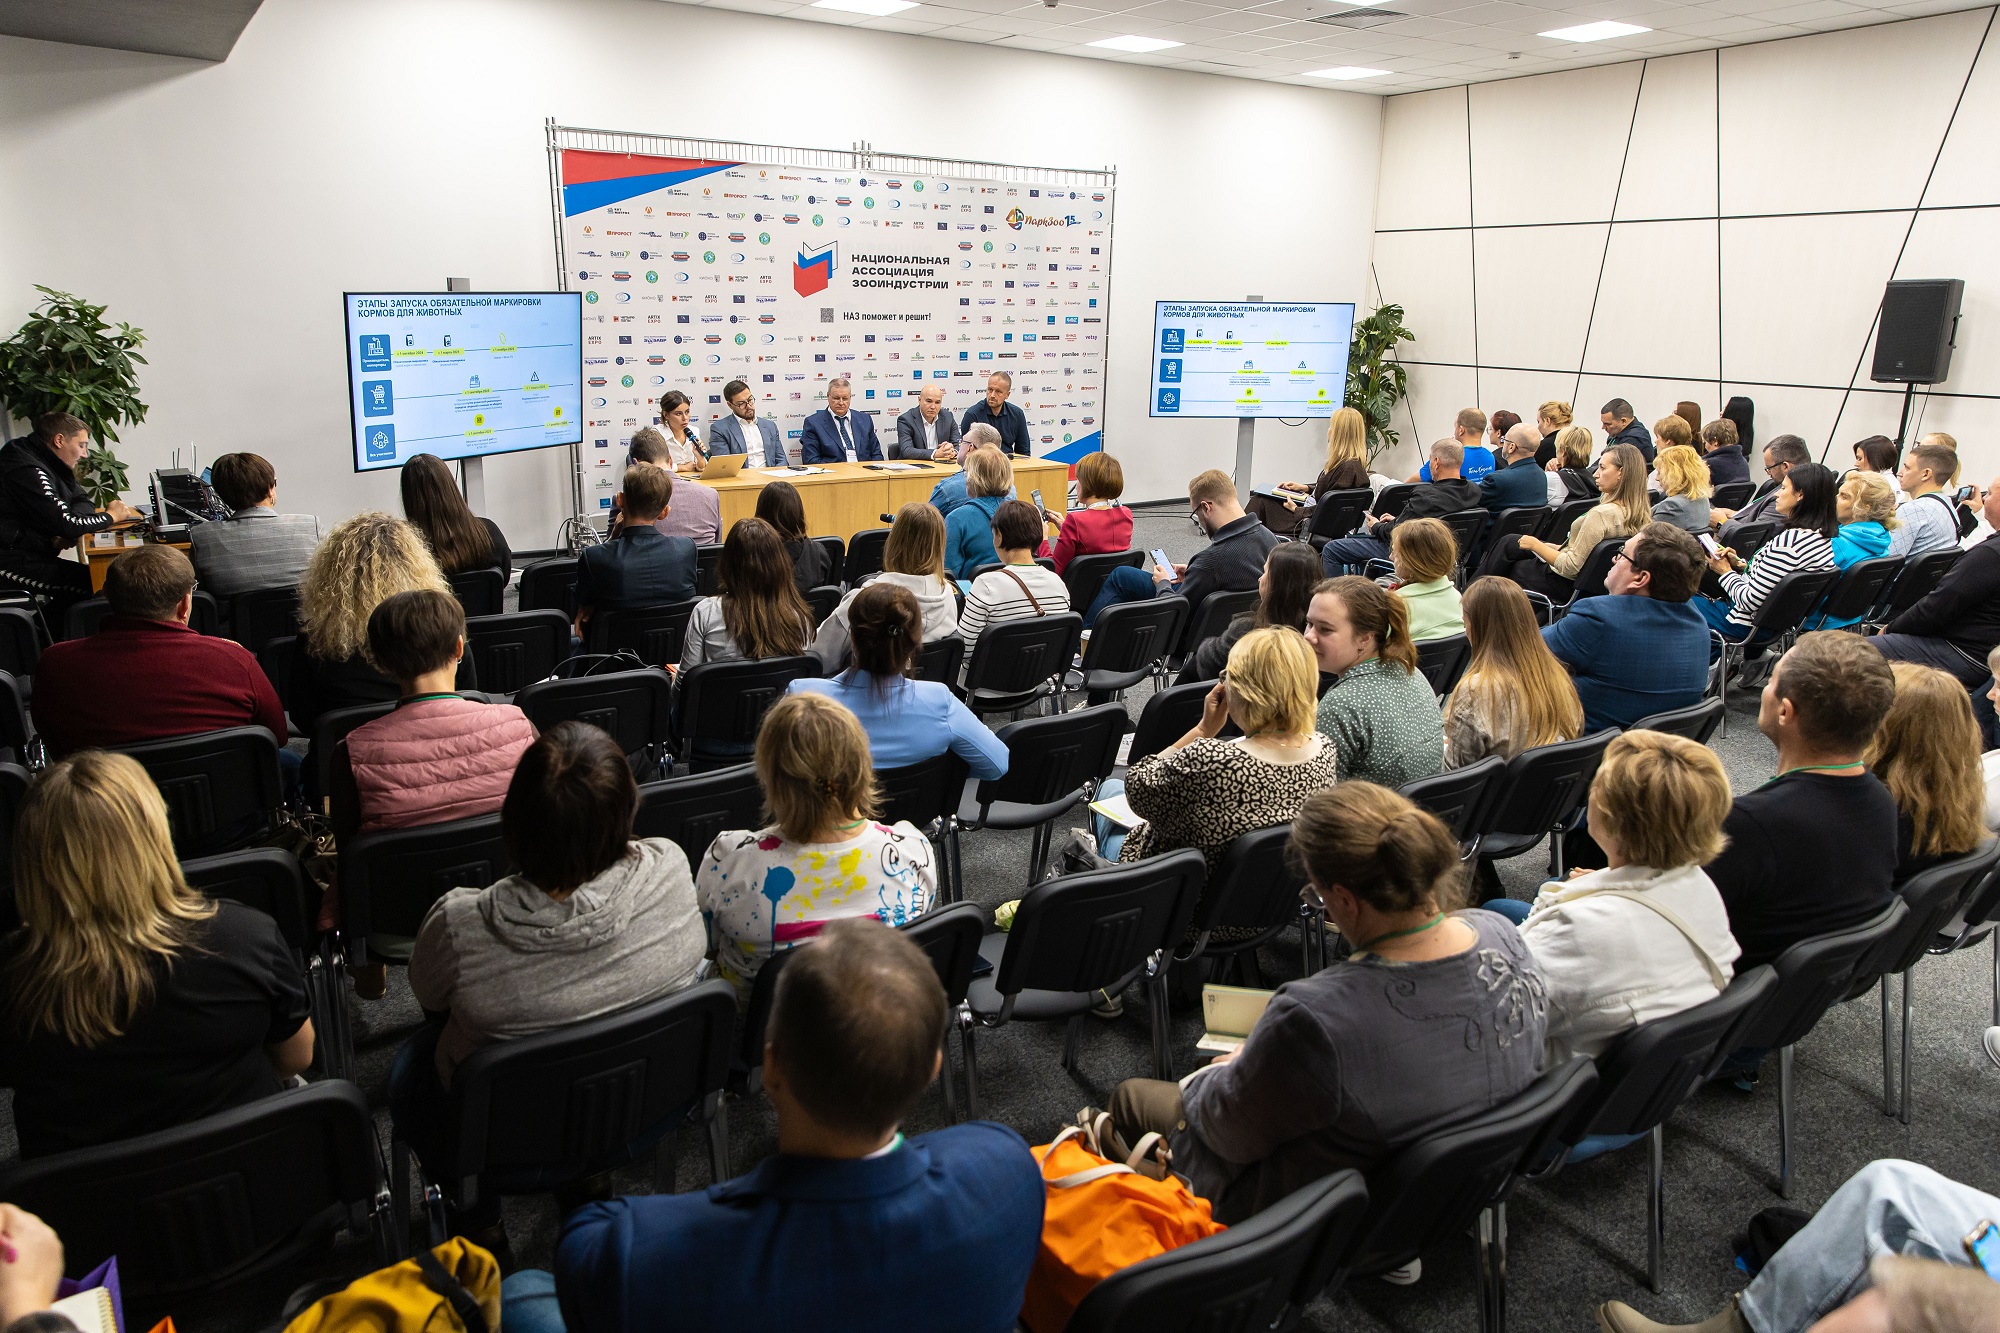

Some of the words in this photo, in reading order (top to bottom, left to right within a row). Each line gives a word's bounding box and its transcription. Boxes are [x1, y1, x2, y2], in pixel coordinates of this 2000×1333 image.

[851, 254, 950, 265] НАЦИОНАЛЬНАЯ
[851, 266, 934, 277] АССОЦИАЦИЯ
[852, 279, 949, 289] ЗООИНДУСТРИИ
[357, 300, 388, 308] ЭТАПЫ
[390, 299, 428, 307] ЗАПУСКА
[430, 298, 491, 307] ОБЯЗАТЕЛЬНОЙ
[493, 298, 542, 306] МАРКИРОВКИ
[358, 309, 395, 318] КОРМОВ
[397, 309, 413, 318] ДЛЯ
[415, 308, 462, 317] ЖИВОТНЫХ
[843, 312, 860, 320] НАЗ
[905, 313, 931, 322] решит!
